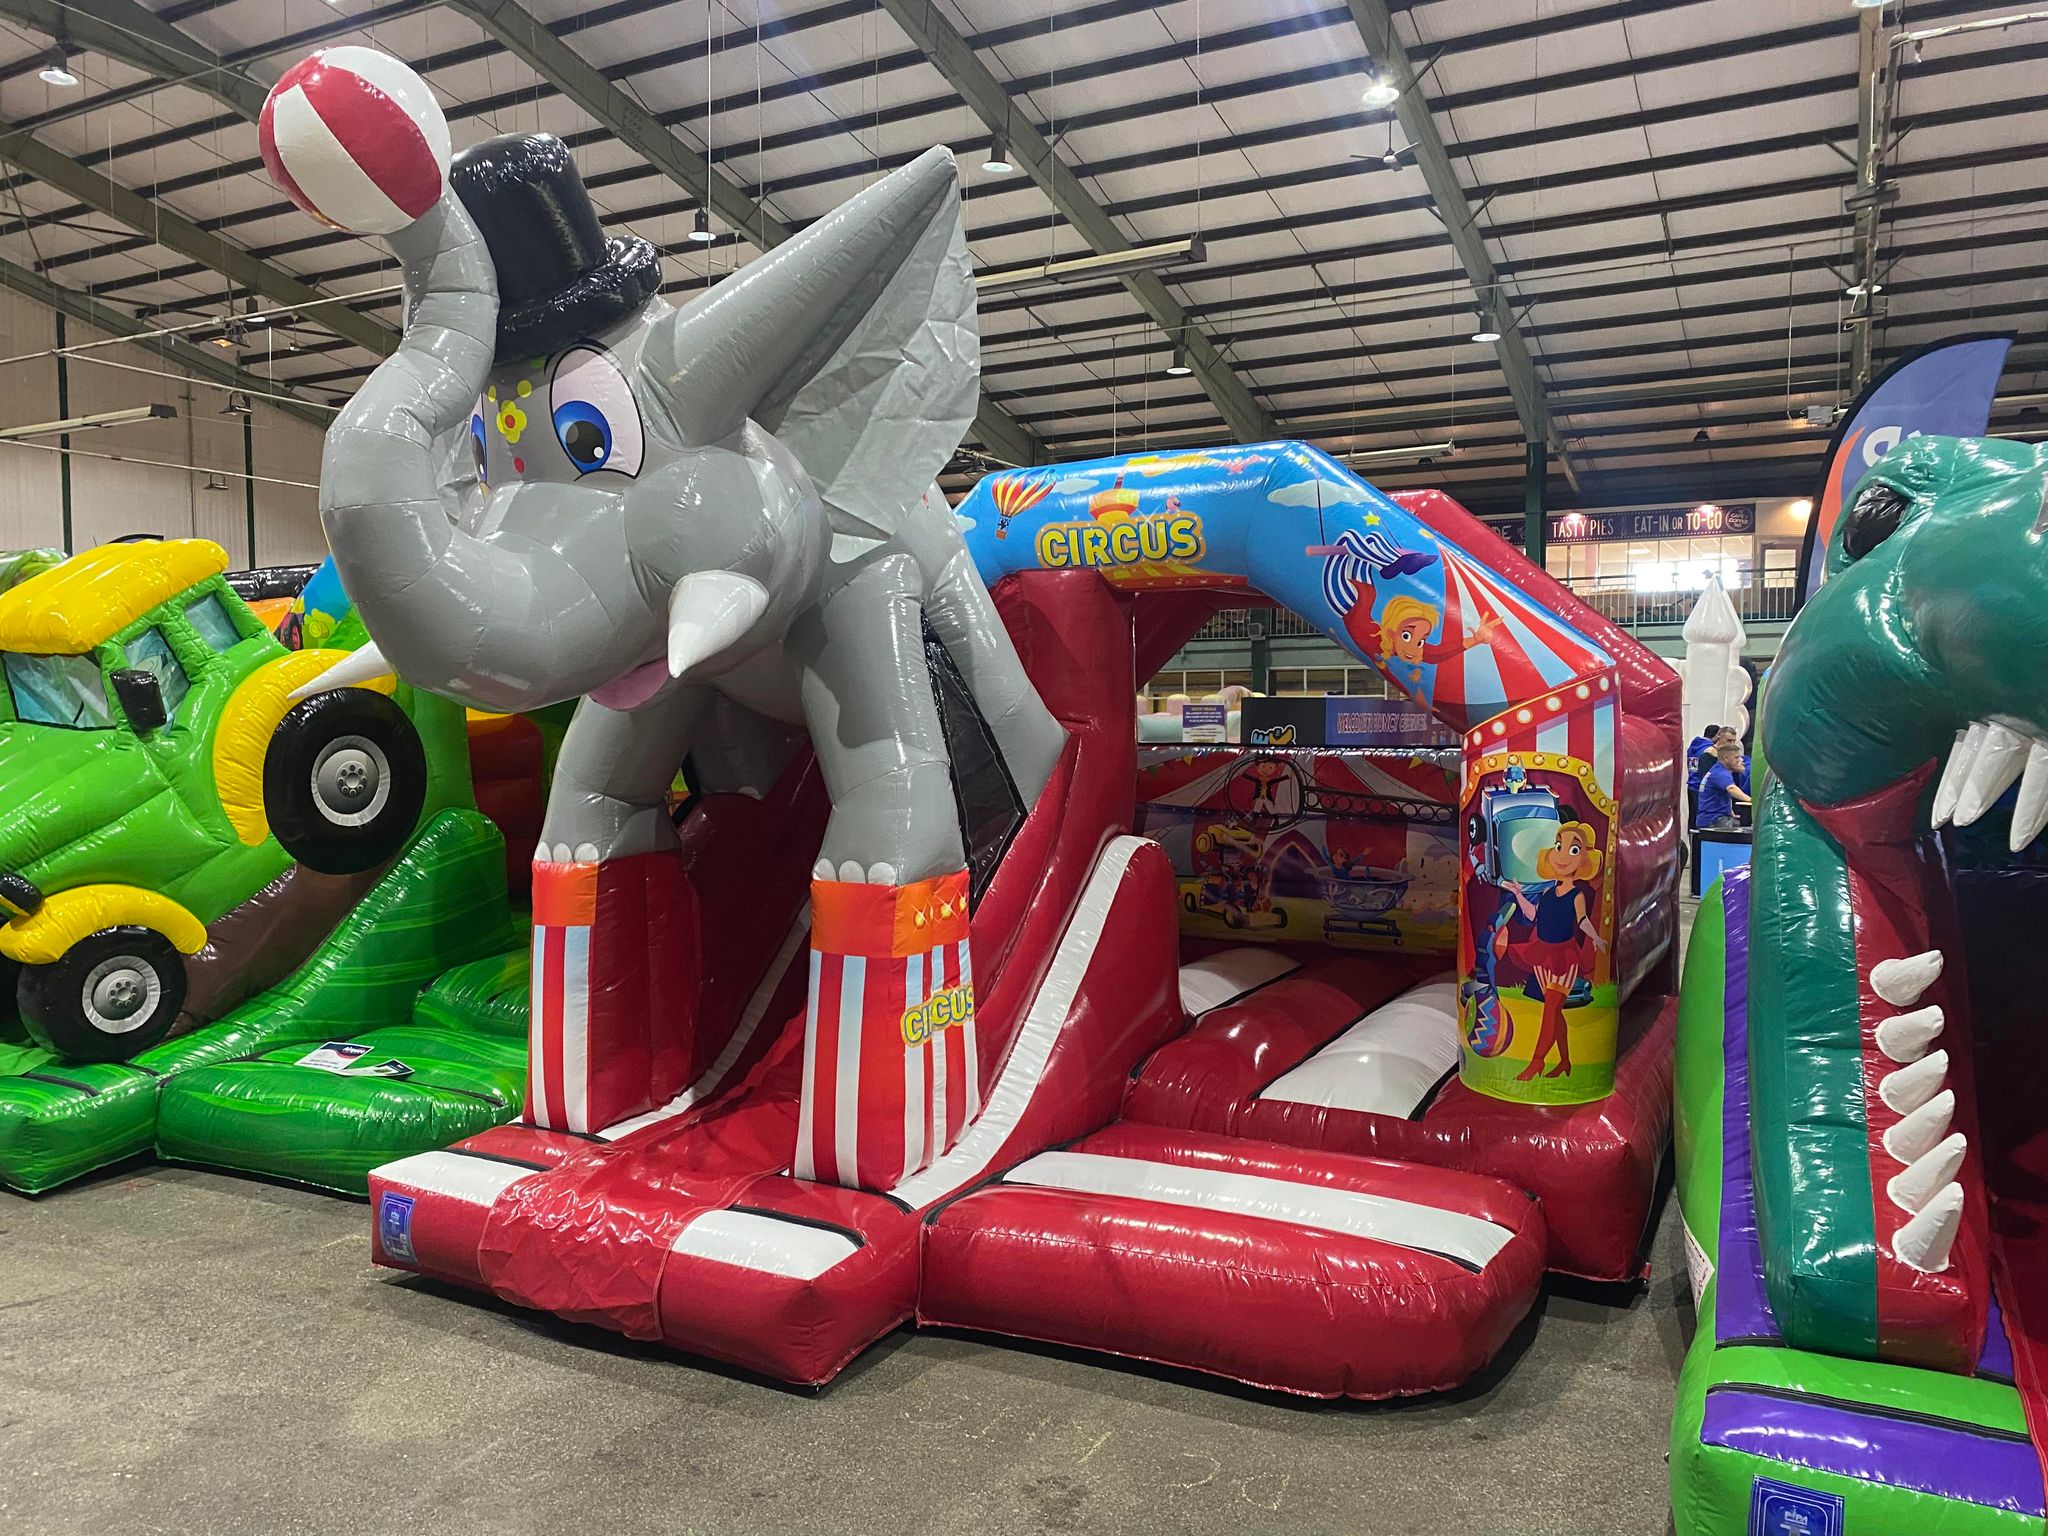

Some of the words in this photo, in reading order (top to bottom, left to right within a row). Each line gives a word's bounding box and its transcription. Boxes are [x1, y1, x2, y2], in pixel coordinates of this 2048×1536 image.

[1552, 519, 1587, 538] TASTY
[1590, 518, 1614, 537] PIES
[1634, 514, 1669, 533] EAT-IN
[1672, 516, 1683, 530] OR
[1686, 511, 1722, 531] TO-GO
[1041, 518, 1199, 567] CIRCUS
[904, 984, 974, 1044] CICUS
